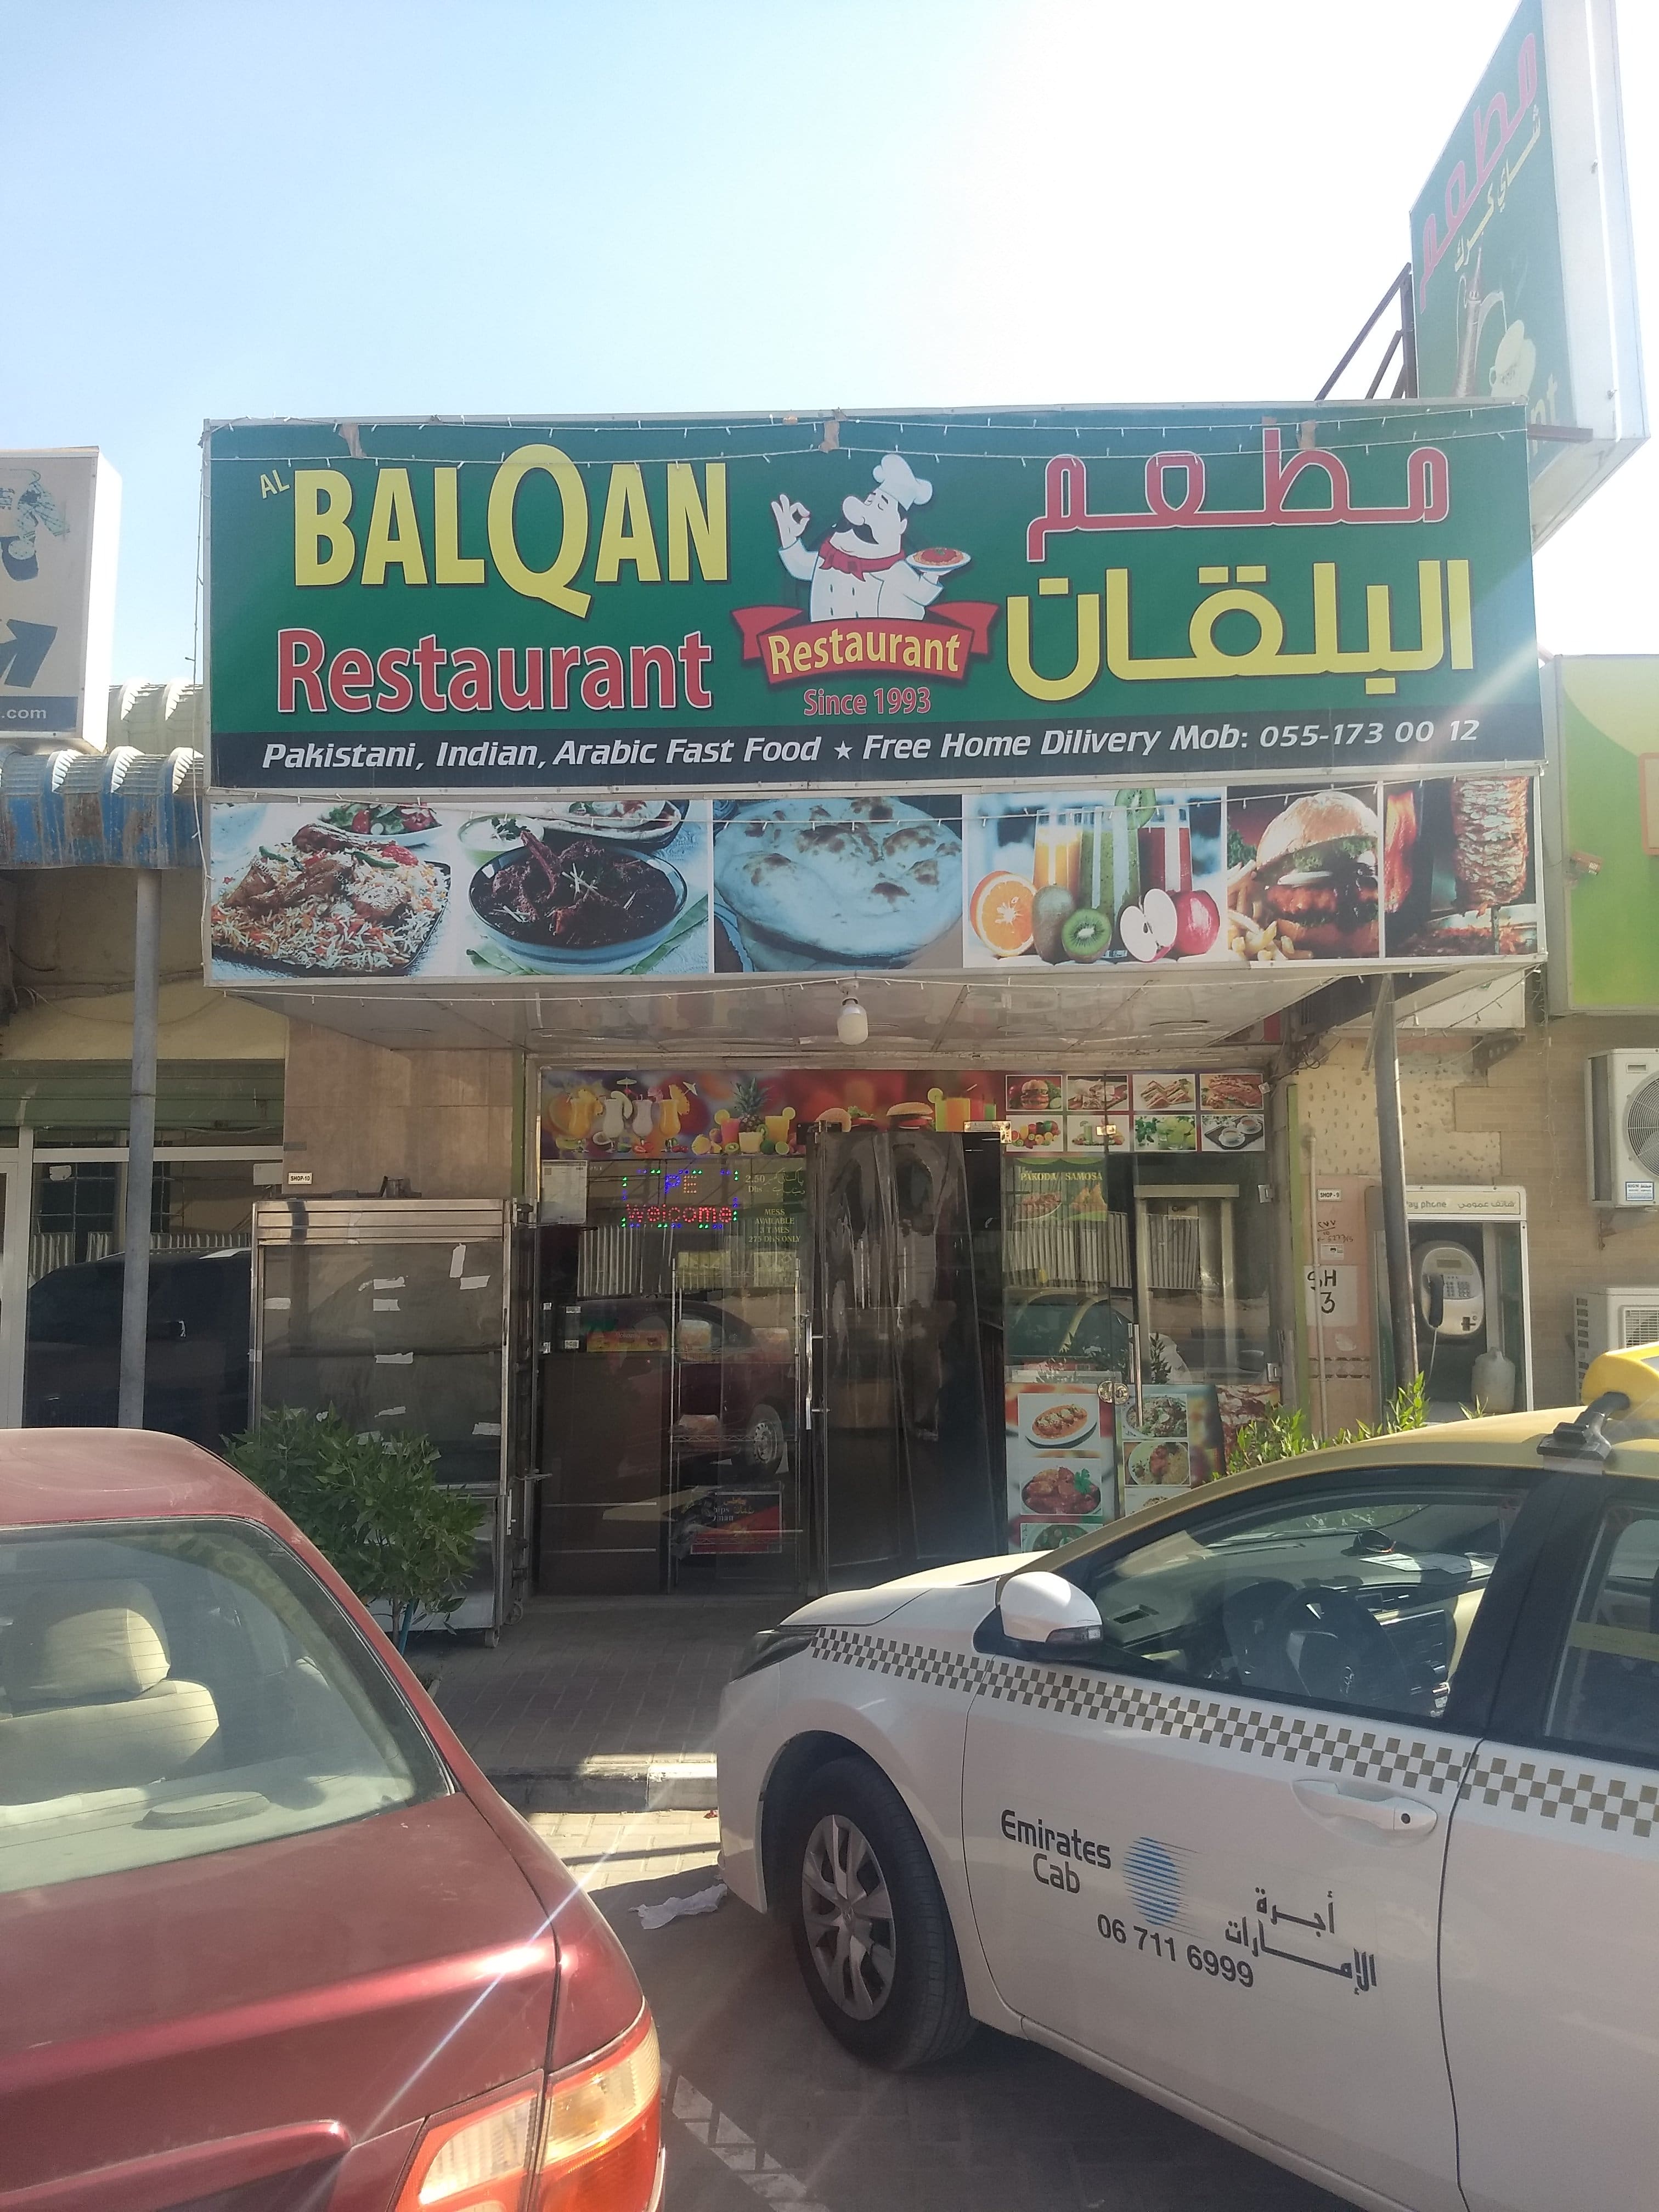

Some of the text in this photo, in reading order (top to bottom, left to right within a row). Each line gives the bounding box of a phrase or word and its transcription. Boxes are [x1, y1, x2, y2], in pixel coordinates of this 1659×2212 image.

[1420, 32, 1537, 314] مطعم
[1026, 427, 1449, 563] مطعم
[259, 443, 728, 619] AL BALQAN
[768, 628, 961, 675] Restaurant
[1007, 560, 1474, 702] البلقان
[278, 628, 713, 714] Restaurant
[804, 687, 932, 716] Since 1993
[262, 719, 1480, 771] Pakistani, Indian, Arabic Fast Food Free Home Dilivery Mob: 055-173 00 12
[746, 1175, 765, 1183] 2.50
[1020, 1172, 1103, 1181] PAKODA SAMOSA
[1406, 1200, 1447, 1209] ay phone
[1321, 1292, 1336, 1313] 3
[1001, 1809, 1111, 1869] Emirates
[1032, 1853, 1080, 1894] Cab
[1255, 1887, 1335, 1937] أجرة
[1098, 1913, 1254, 1988] 06 711 6999
[1225, 1917, 1377, 1995] الإمارات
